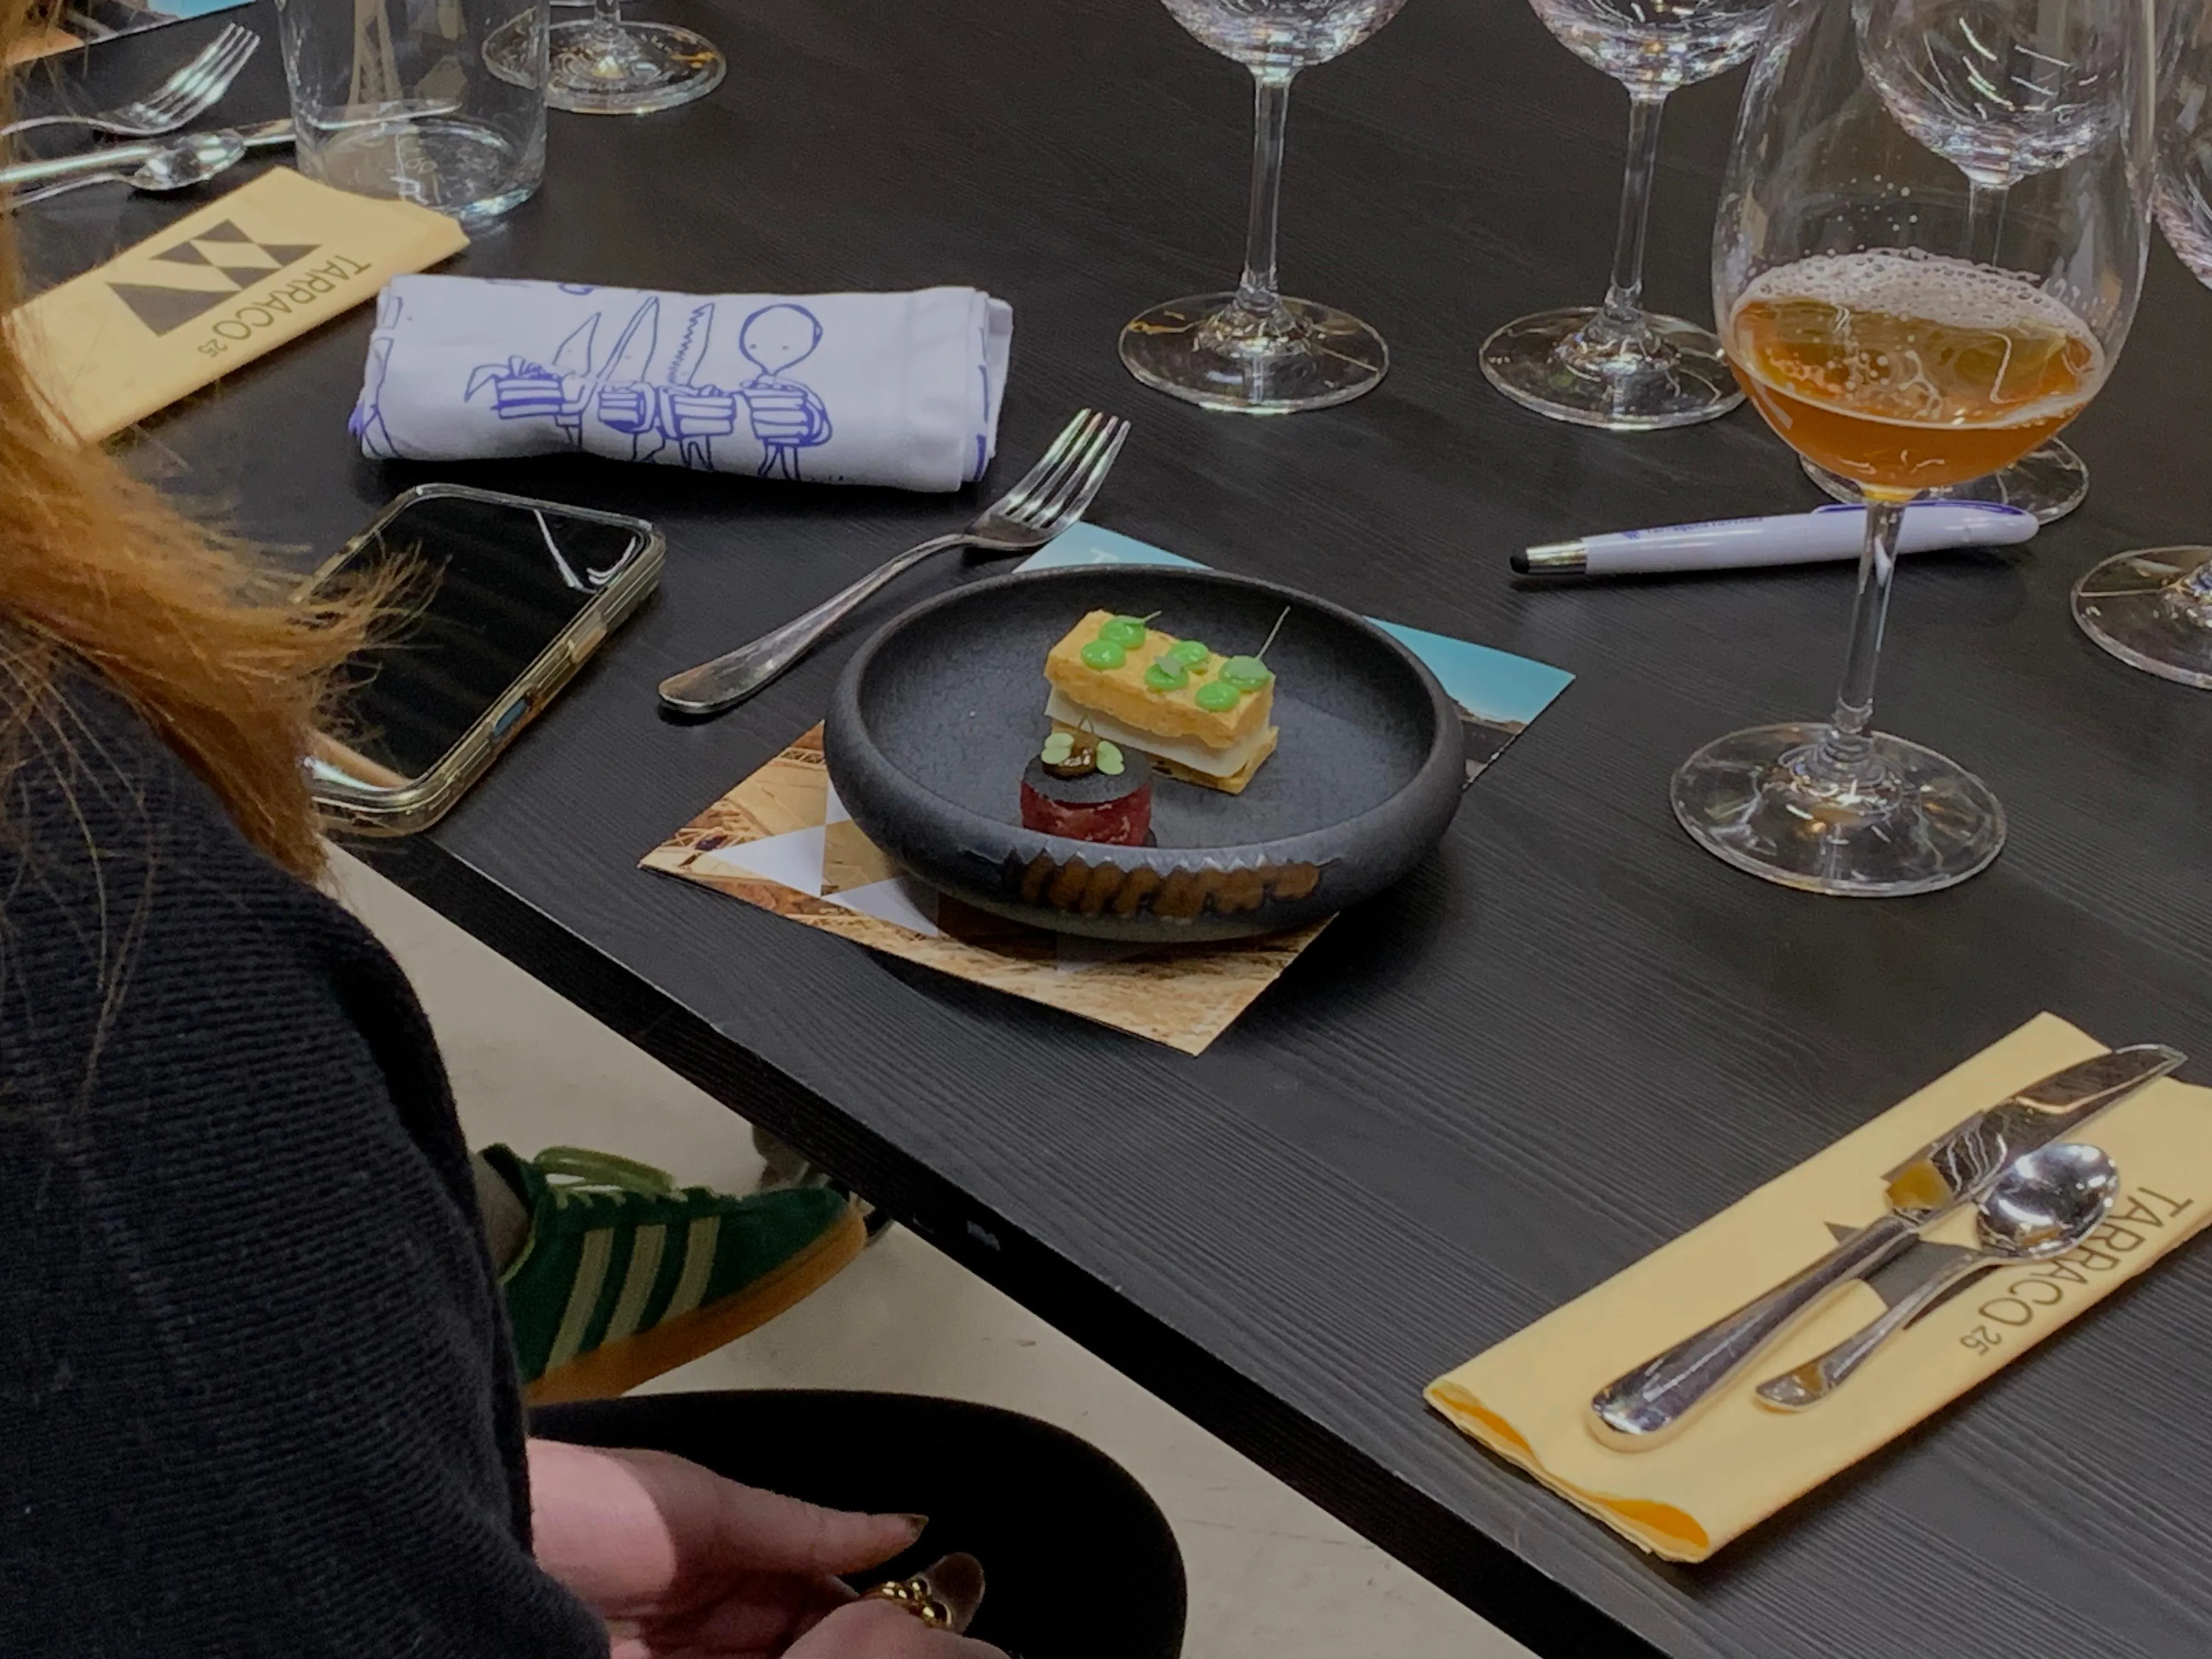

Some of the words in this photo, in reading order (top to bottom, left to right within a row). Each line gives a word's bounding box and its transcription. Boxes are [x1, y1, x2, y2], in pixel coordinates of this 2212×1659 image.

[212, 255, 371, 340] TARRACO
[198, 338, 229, 358] 25
[1978, 1187, 2194, 1327] TARRACO
[1960, 1325, 2002, 1356] 25
